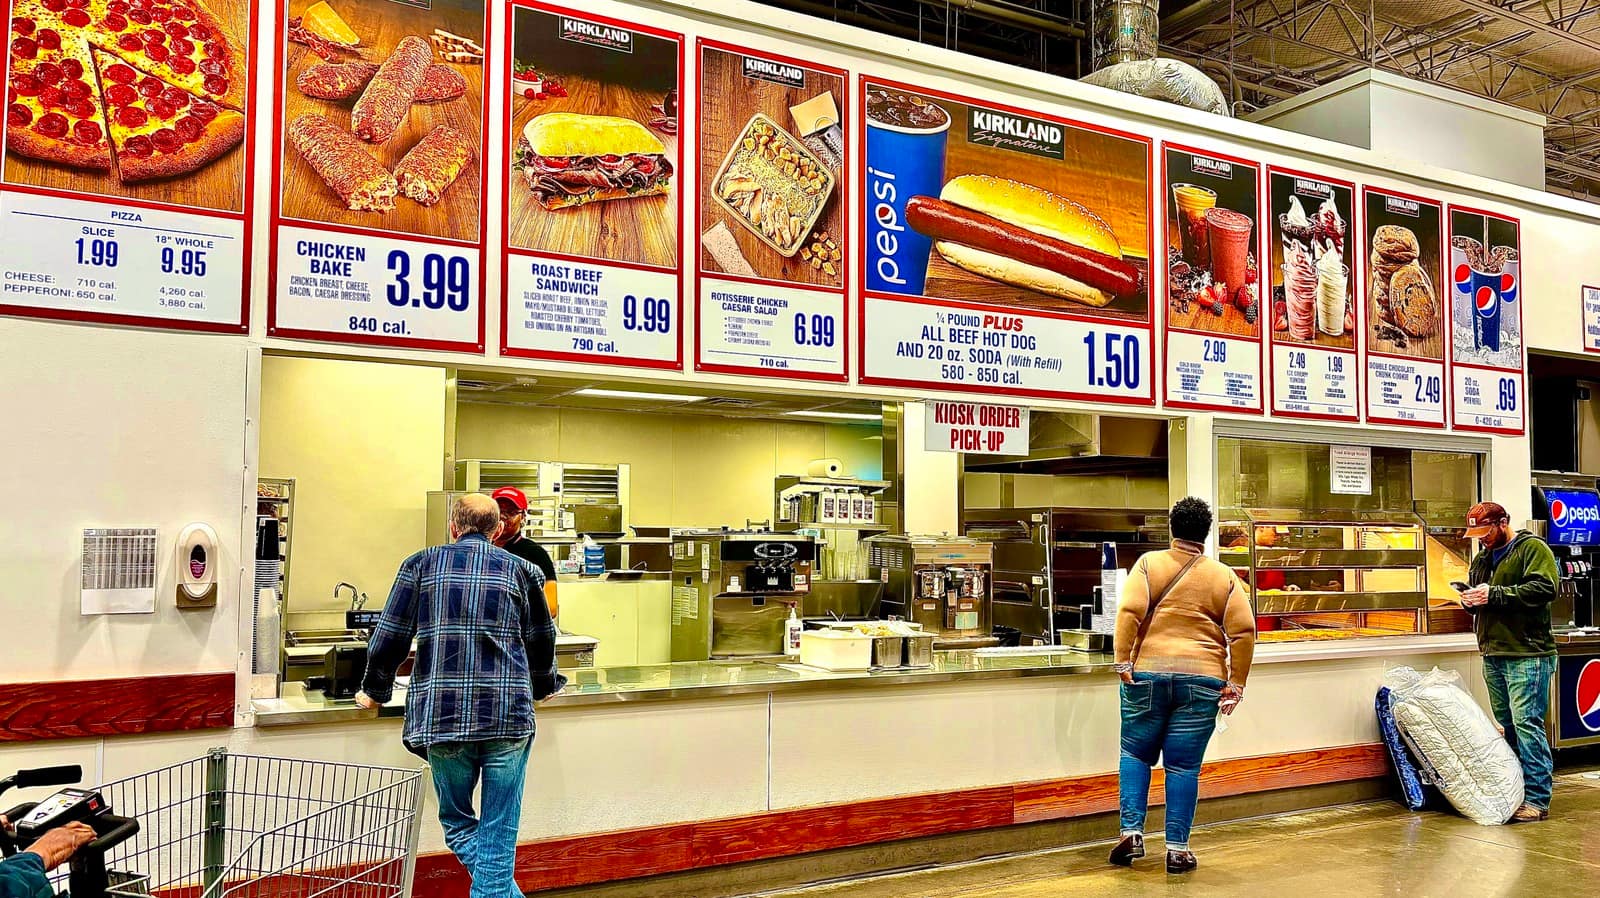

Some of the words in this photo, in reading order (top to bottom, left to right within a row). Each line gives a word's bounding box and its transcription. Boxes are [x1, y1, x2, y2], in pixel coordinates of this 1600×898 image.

[564, 19, 630, 43] KIRKLAND
[745, 58, 803, 80] KIRKLAND
[973, 110, 1062, 144] KIRKLAND
[973, 130, 1061, 154] Signature
[1193, 156, 1231, 173] KIRKLAND
[1296, 179, 1330, 193] KIRKLAND
[111, 210, 143, 223] PIZZA
[868, 166, 907, 285] pepsi
[82, 226, 115, 238] SLICE
[155, 235, 172, 245] 18"
[175, 237, 214, 249] WHOLE
[297, 240, 366, 262] CHICKEN
[76, 237, 119, 268] 1.99
[161, 247, 206, 277] 9.95
[310, 259, 352, 277] BAKE
[531, 263, 571, 280] ROAST
[574, 268, 603, 283] BEEF
[5, 271, 56, 284] CHEESE:
[77, 279, 96, 288] 710
[98, 281, 117, 290] cal.
[290, 276, 317, 288] CHICKEN
[386, 249, 470, 312] 3.99
[536, 278, 598, 296] SANDWICH
[4, 284, 75, 298] PEPPERONI:
[76, 290, 96, 300] 650
[98, 292, 117, 302] cal.
[159, 286, 186, 297] 4,260
[189, 288, 206, 299] cal.
[289, 286, 313, 298] BACON,
[315, 288, 339, 300] CAESAR
[341, 291, 371, 302] DRESSING
[711, 292, 755, 305] ROTISSERIE
[756, 297, 788, 309] CHICKEN
[159, 298, 186, 308] 3,880
[189, 300, 206, 310] cal.
[722, 302, 752, 313] CAESAR
[754, 306, 778, 316] SALAD
[623, 294, 671, 334] 9.99
[948, 314, 981, 328] POUND
[983, 315, 1024, 332] PLUS
[349, 316, 377, 332] 840
[383, 320, 411, 335] cal.
[794, 312, 835, 347] 6.99
[572, 337, 594, 351] 790
[597, 341, 618, 353] cal.
[921, 326, 945, 342] ALL
[949, 328, 979, 346] BEEF
[982, 332, 1008, 348] HOT
[1012, 335, 1037, 351] DOG
[896, 342, 924, 358] AND
[928, 345, 943, 360] 20
[947, 350, 965, 363] oz.
[968, 349, 1002, 366] SODA
[1006, 355, 1032, 369] (With
[1034, 357, 1063, 374] Refill)
[1083, 331, 1140, 390] 1.50
[1203, 339, 1227, 363] 2.99
[1289, 351, 1306, 369] 2.49
[760, 358, 774, 367] 710
[776, 360, 790, 368] cal.
[1327, 355, 1343, 373] 1.99
[1369, 361, 1387, 371] DOUBLE
[1388, 364, 1415, 374] CHOCOLATE
[942, 365, 965, 381] 580
[977, 368, 999, 384] 850
[1002, 371, 1023, 386] cal.
[1375, 370, 1391, 379] CHUNK
[1392, 372, 1409, 381] COOKIE
[1464, 376, 1472, 385] 20
[1415, 374, 1440, 404] 2.49
[1464, 386, 1480, 397] SODA
[1496, 378, 1516, 411] .69
[935, 402, 975, 426] KIOSK
[979, 405, 1020, 428] ORDER
[950, 428, 1005, 452] PICK-UP
[1569, 504, 1600, 525] pepsi
